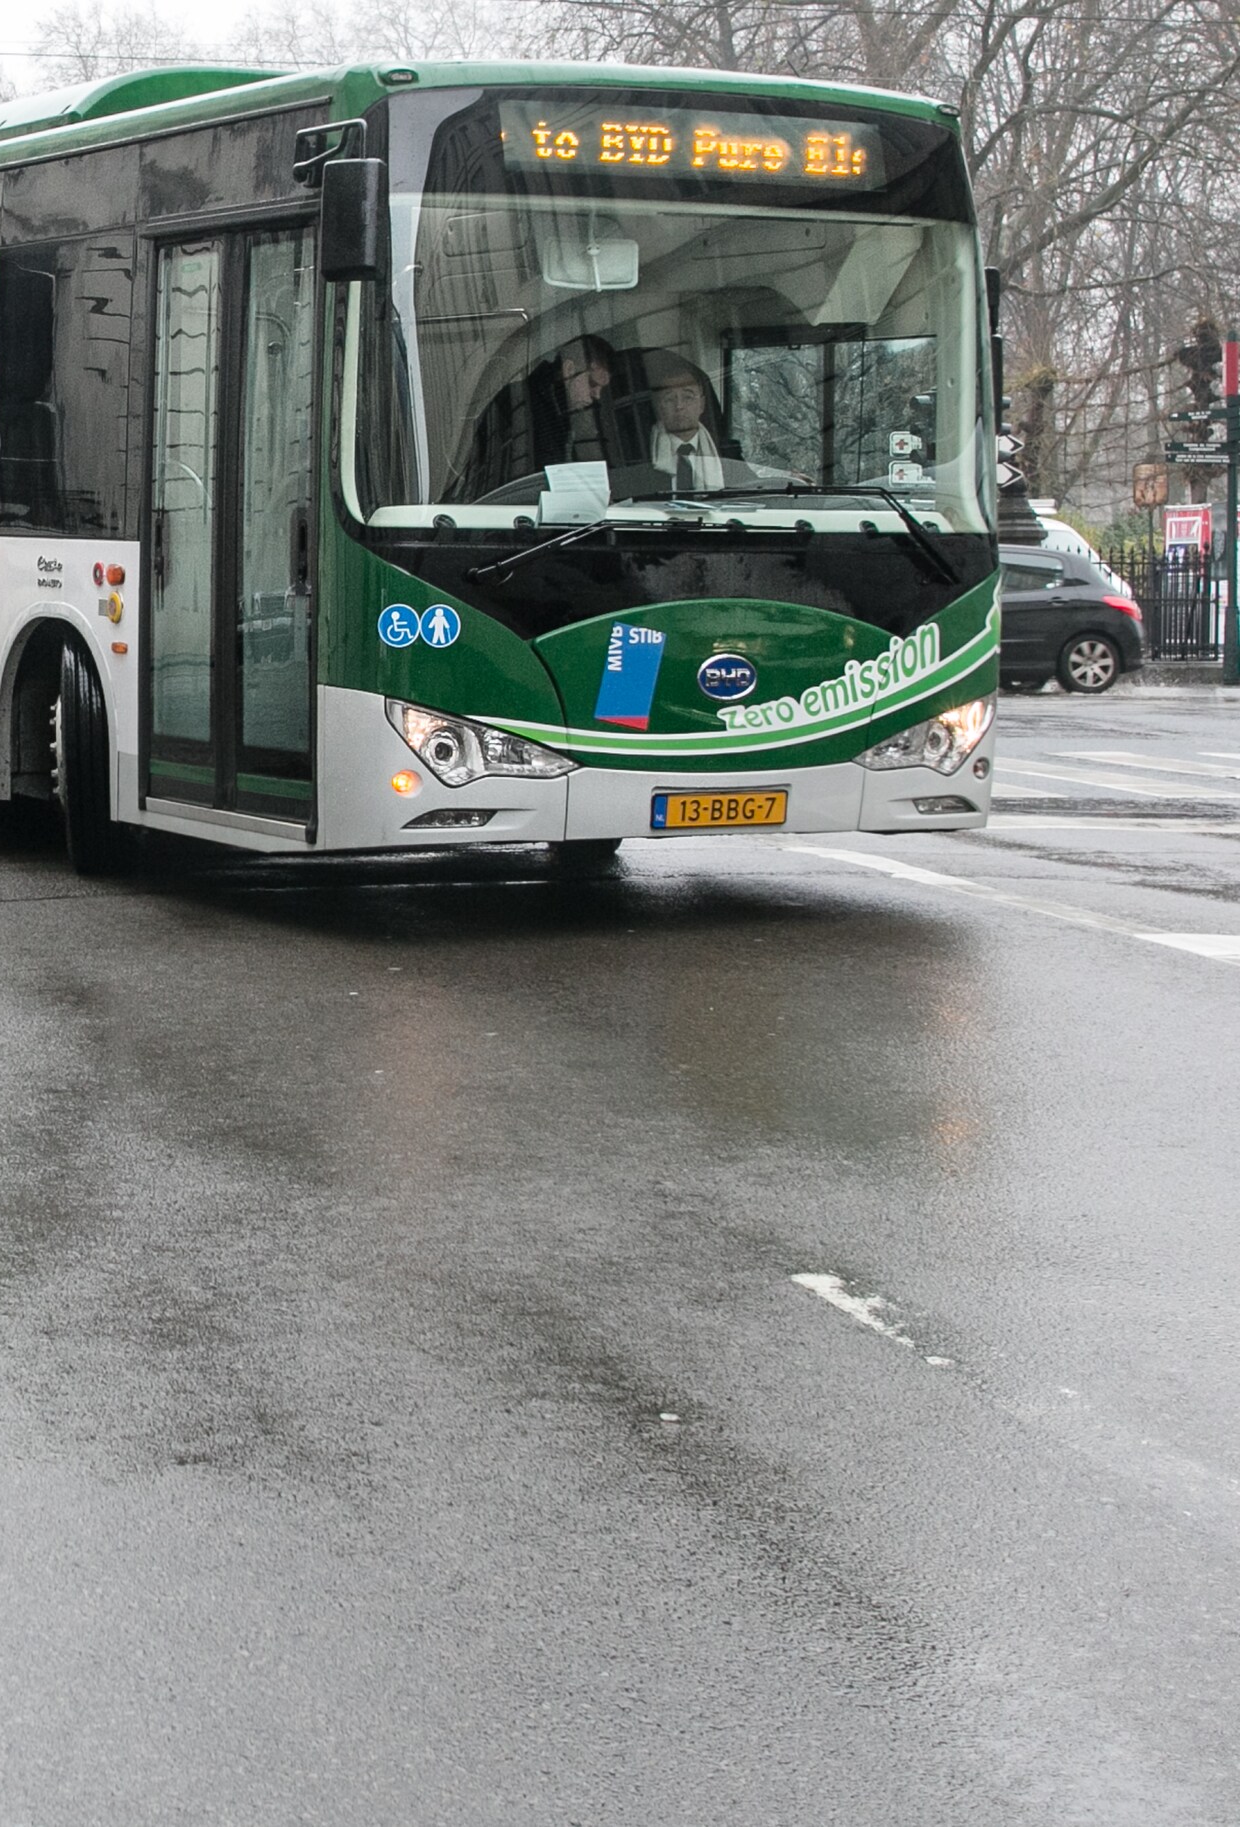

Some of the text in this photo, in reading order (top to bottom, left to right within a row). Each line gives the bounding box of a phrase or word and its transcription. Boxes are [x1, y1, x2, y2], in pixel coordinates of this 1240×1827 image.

[532, 121, 579, 158] to
[599, 122, 673, 164] BYD
[691, 128, 786, 172] Pure
[607, 626, 663, 672] MIVB STIB
[803, 624, 938, 717] emission
[705, 667, 751, 688] BYD
[680, 797, 777, 822] 13-BBG-7
